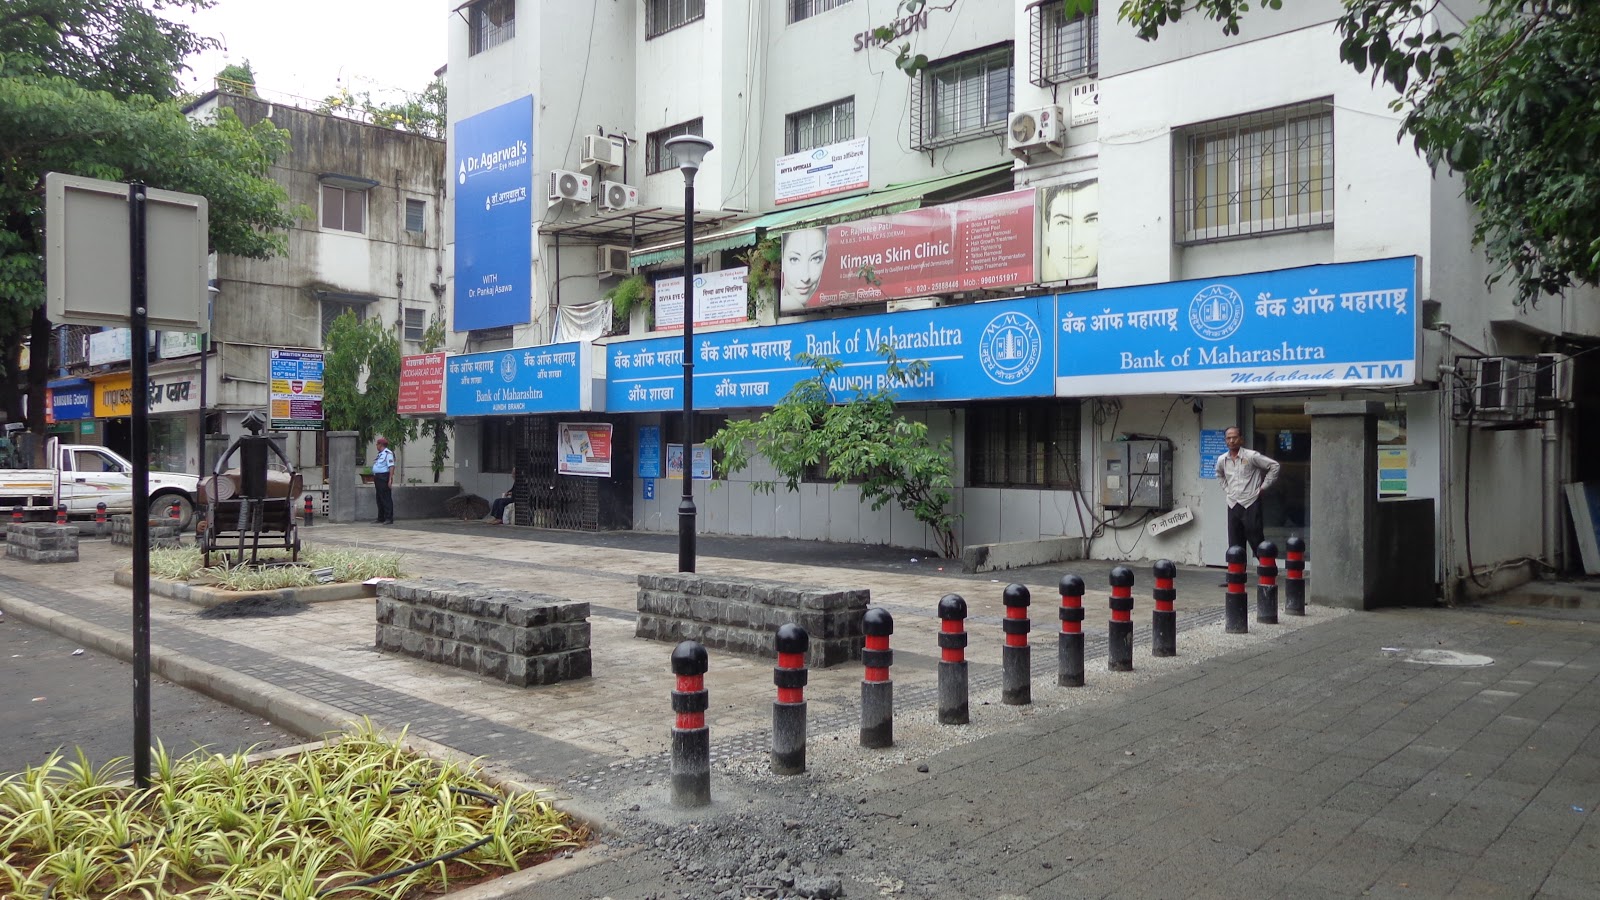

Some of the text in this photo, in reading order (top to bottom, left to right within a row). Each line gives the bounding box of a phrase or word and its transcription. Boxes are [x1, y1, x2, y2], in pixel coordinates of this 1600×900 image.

[854, 11, 927, 51] SHKUN
[499, 156, 526, 171] Eye Hospital
[793, 163, 811, 172] OPTICALS
[993, 229, 1011, 237] Removal
[886, 247, 910, 263] Skin
[915, 241, 949, 258] Clinic
[998, 253, 1025, 262] Pigmentation
[483, 273, 497, 284] WITH
[477, 286, 494, 296] Pankaj
[495, 285, 512, 294] Asawa
[1255, 287, 1408, 318] बैंक ऑफ महाराष्ट्र
[1090, 308, 1123, 331] ऑफ
[1127, 308, 1178, 331] महाराष्ट्र
[806, 321, 962, 356] Bank of Maharashtra
[633, 348, 654, 367] ऑफ
[657, 350, 684, 366] महारा
[701, 339, 792, 361] बैंक ऑफ महाराष्ट्र
[1120, 342, 1325, 369] Bank of Maharashtra
[430, 367, 442, 375] CLINIC
[1231, 364, 1403, 384] Mahabank ATM
[829, 371, 934, 391] AUNDH BRANCH
[477, 386, 543, 402] Bank of Maharashtra
[649, 387, 674, 401] शाखा
[740, 382, 769, 398] शाखा
[54, 394, 88, 408] SAMSUNG Galaxy
